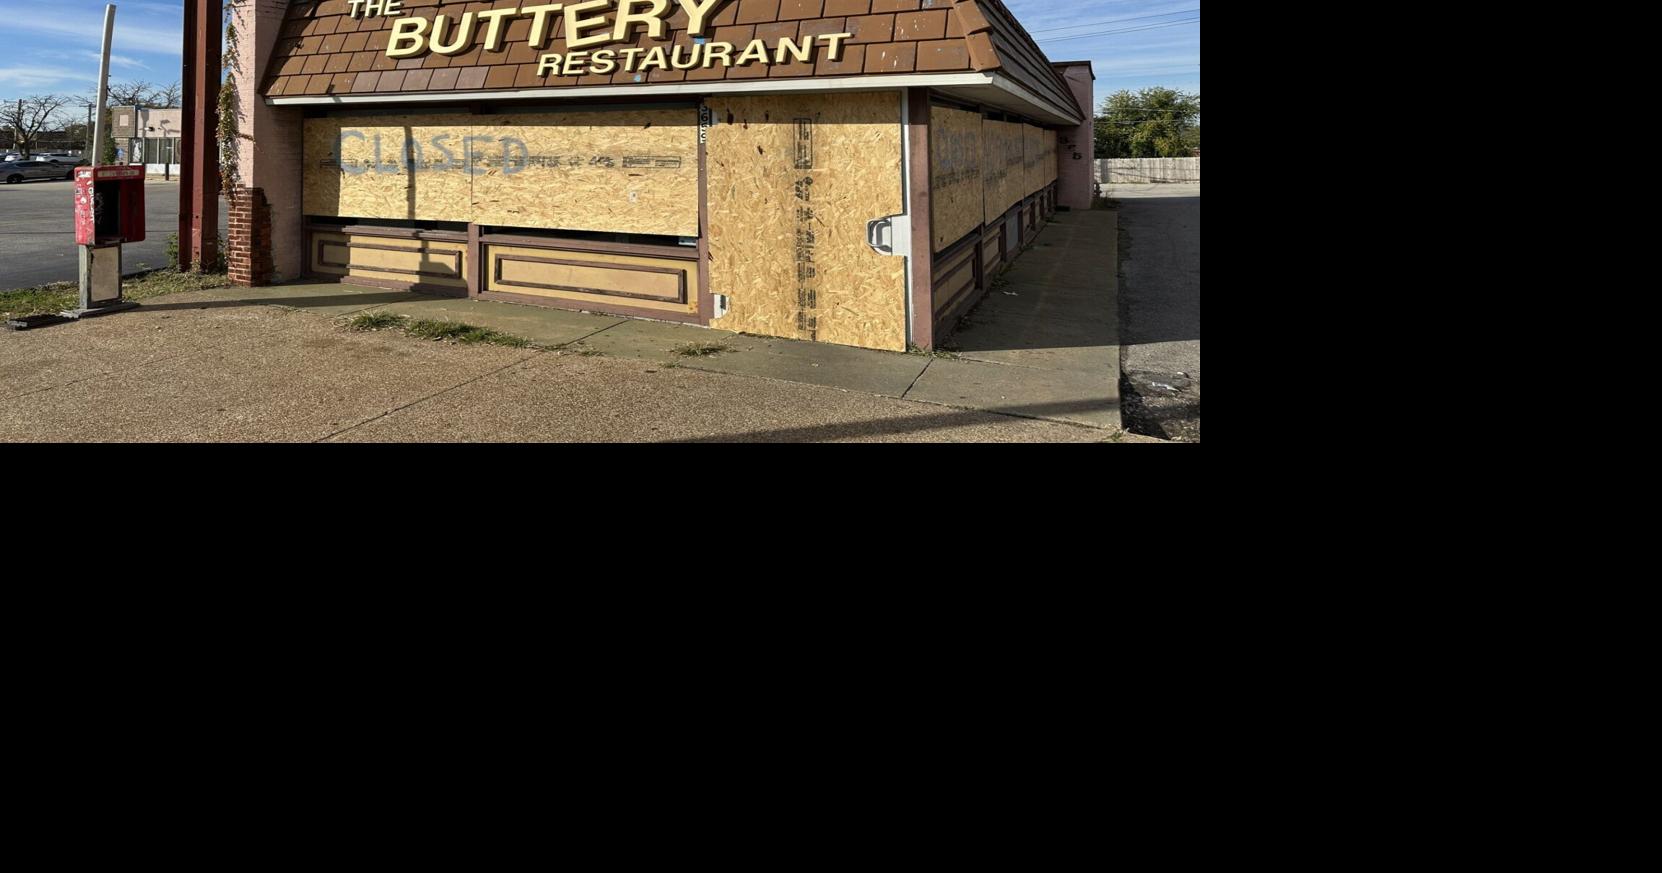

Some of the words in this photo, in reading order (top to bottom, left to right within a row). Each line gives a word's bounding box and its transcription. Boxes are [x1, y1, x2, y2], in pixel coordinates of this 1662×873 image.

[348, 0, 402, 18] THE
[385, 0, 721, 58] BUTTERY
[536, 32, 853, 77] RESTAURANT
[333, 130, 529, 175] CLOSED
